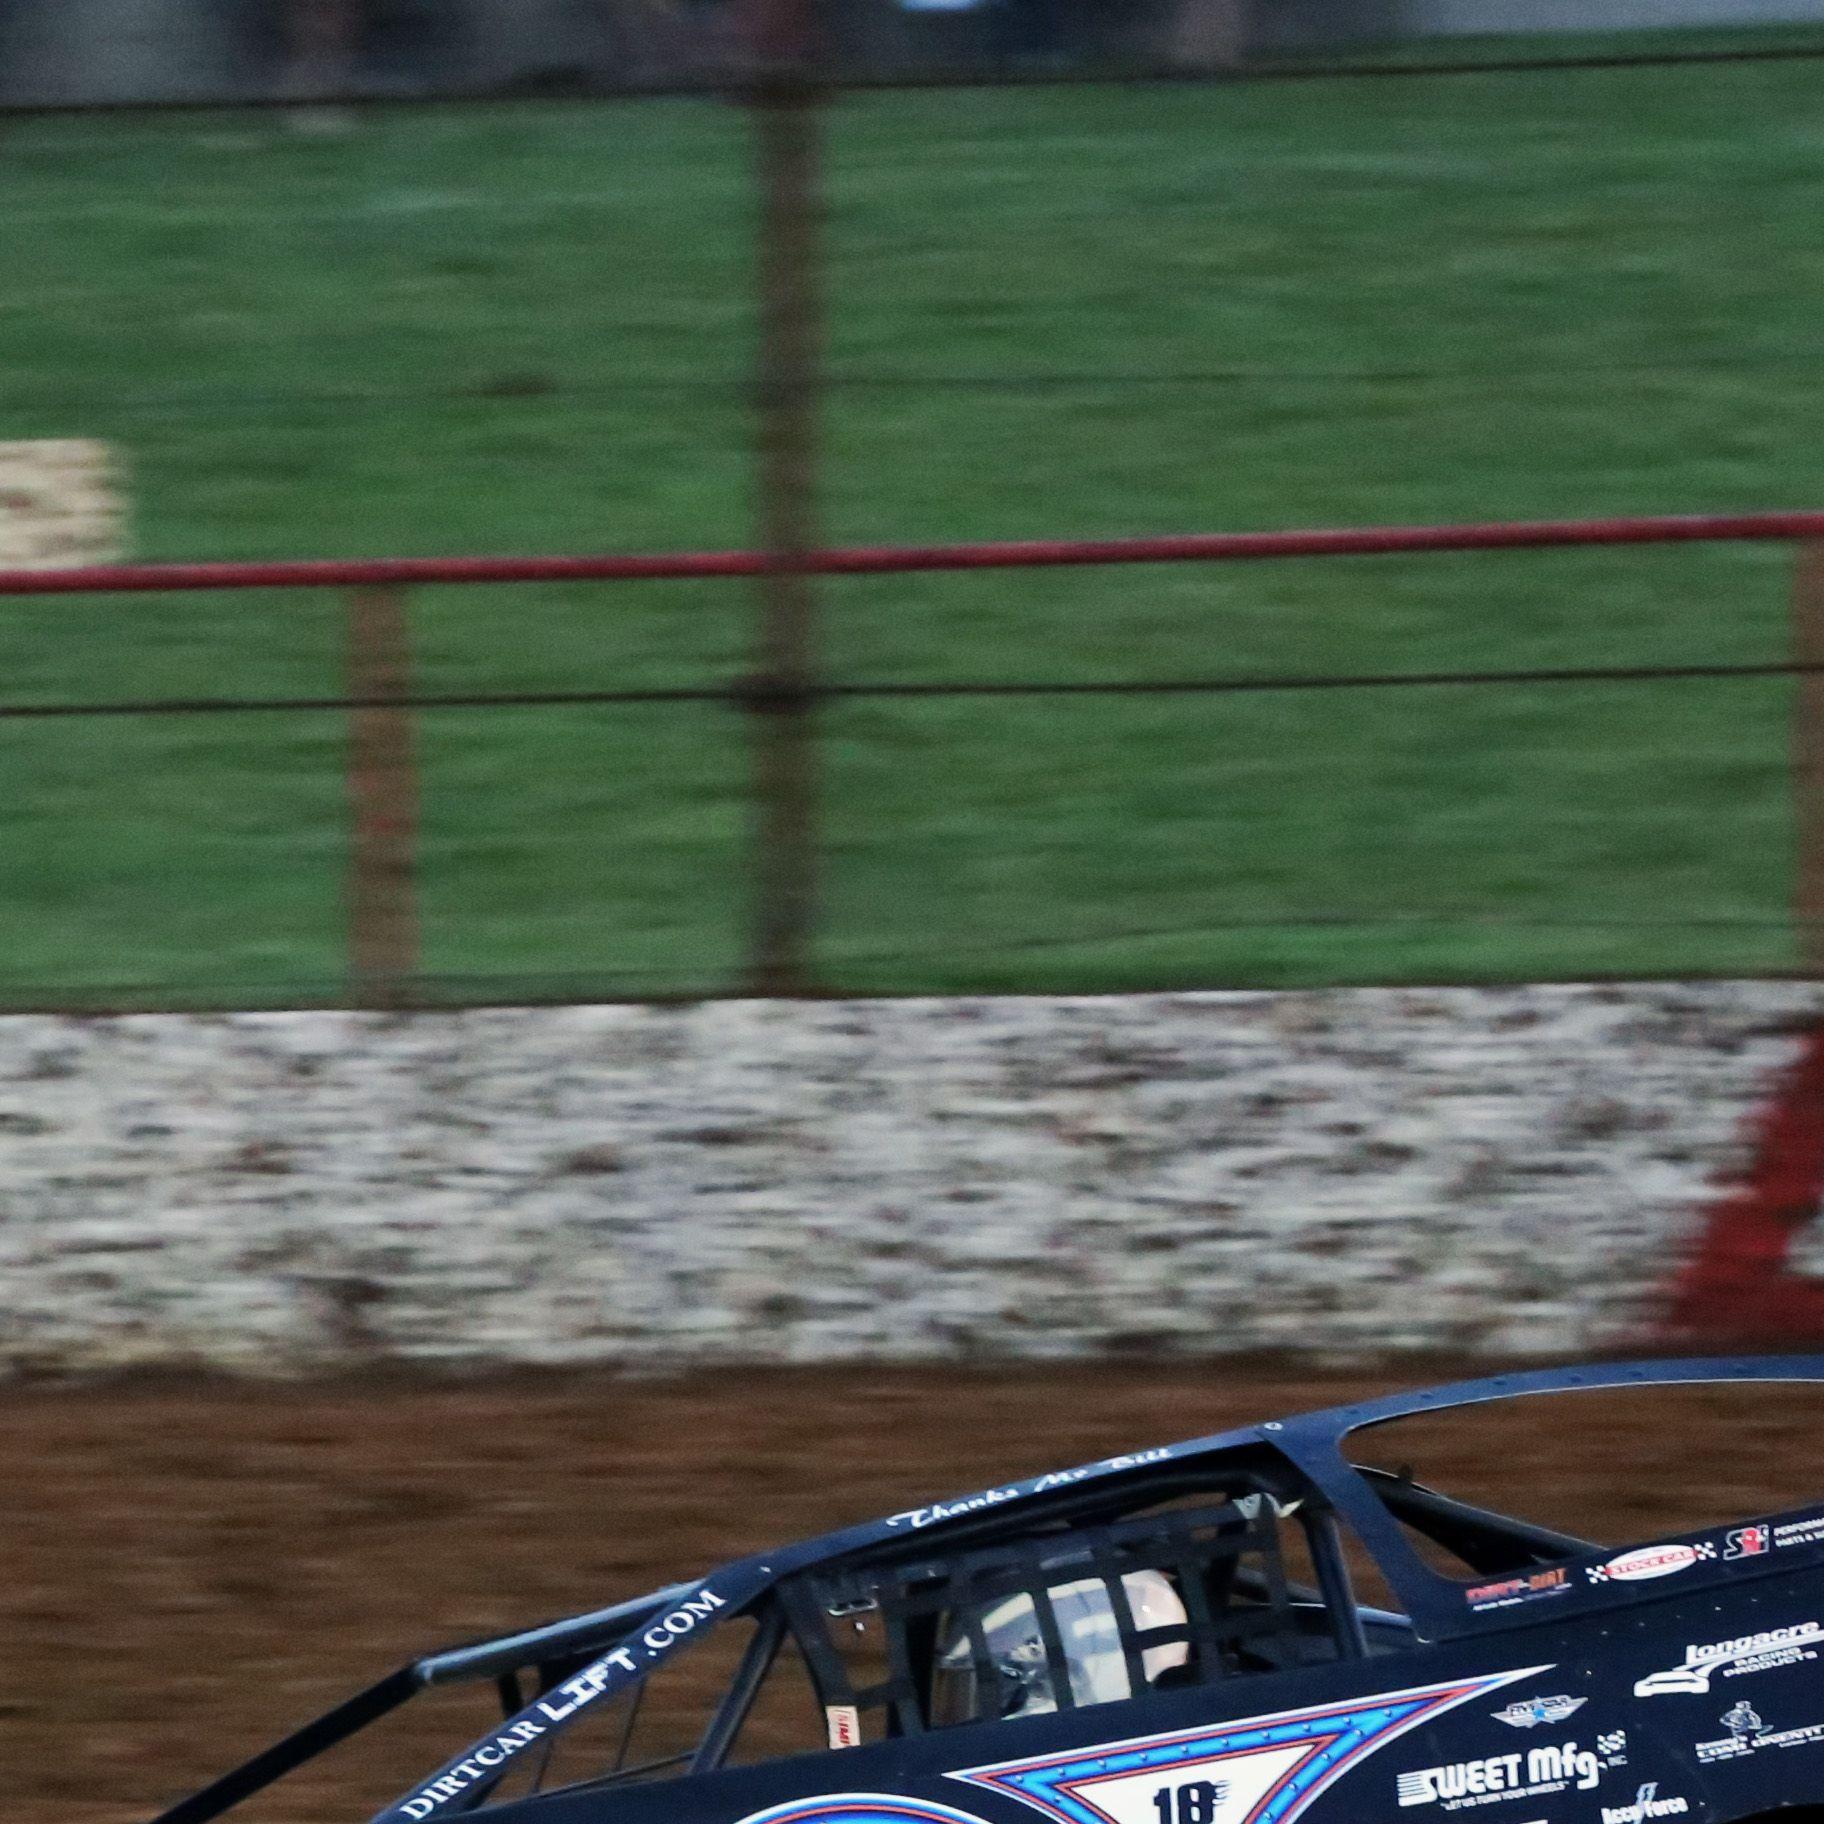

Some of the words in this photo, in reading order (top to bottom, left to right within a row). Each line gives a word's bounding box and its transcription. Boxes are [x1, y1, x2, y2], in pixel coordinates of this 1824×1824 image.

[1686, 1621, 1819, 1666] Longacre
[399, 1719, 546, 1820] DIRTCAR
[536, 1646, 637, 1722] LIFT
[643, 1588, 727, 1657] .COM
[1397, 1753, 1523, 1807] SWEET
